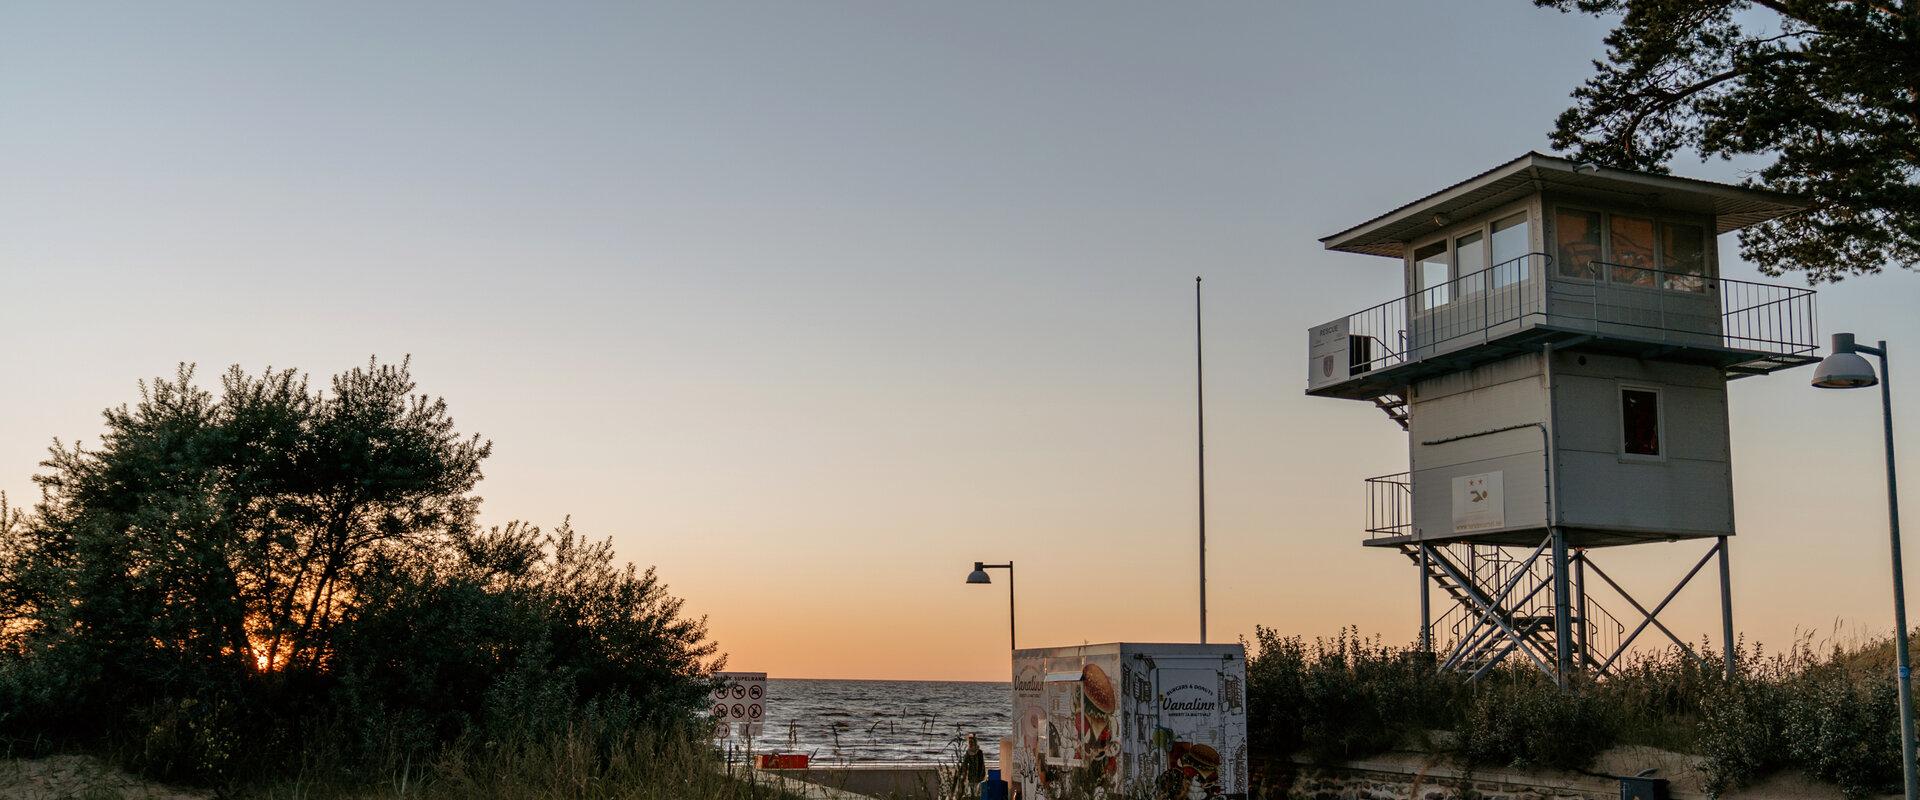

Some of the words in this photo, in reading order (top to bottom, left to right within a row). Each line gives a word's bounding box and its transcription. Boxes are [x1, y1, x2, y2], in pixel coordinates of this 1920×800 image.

[1166, 684, 1188, 696] BURGERS
[1193, 684, 1213, 696] DONUTS
[1162, 697, 1215, 711] Vanalinn
